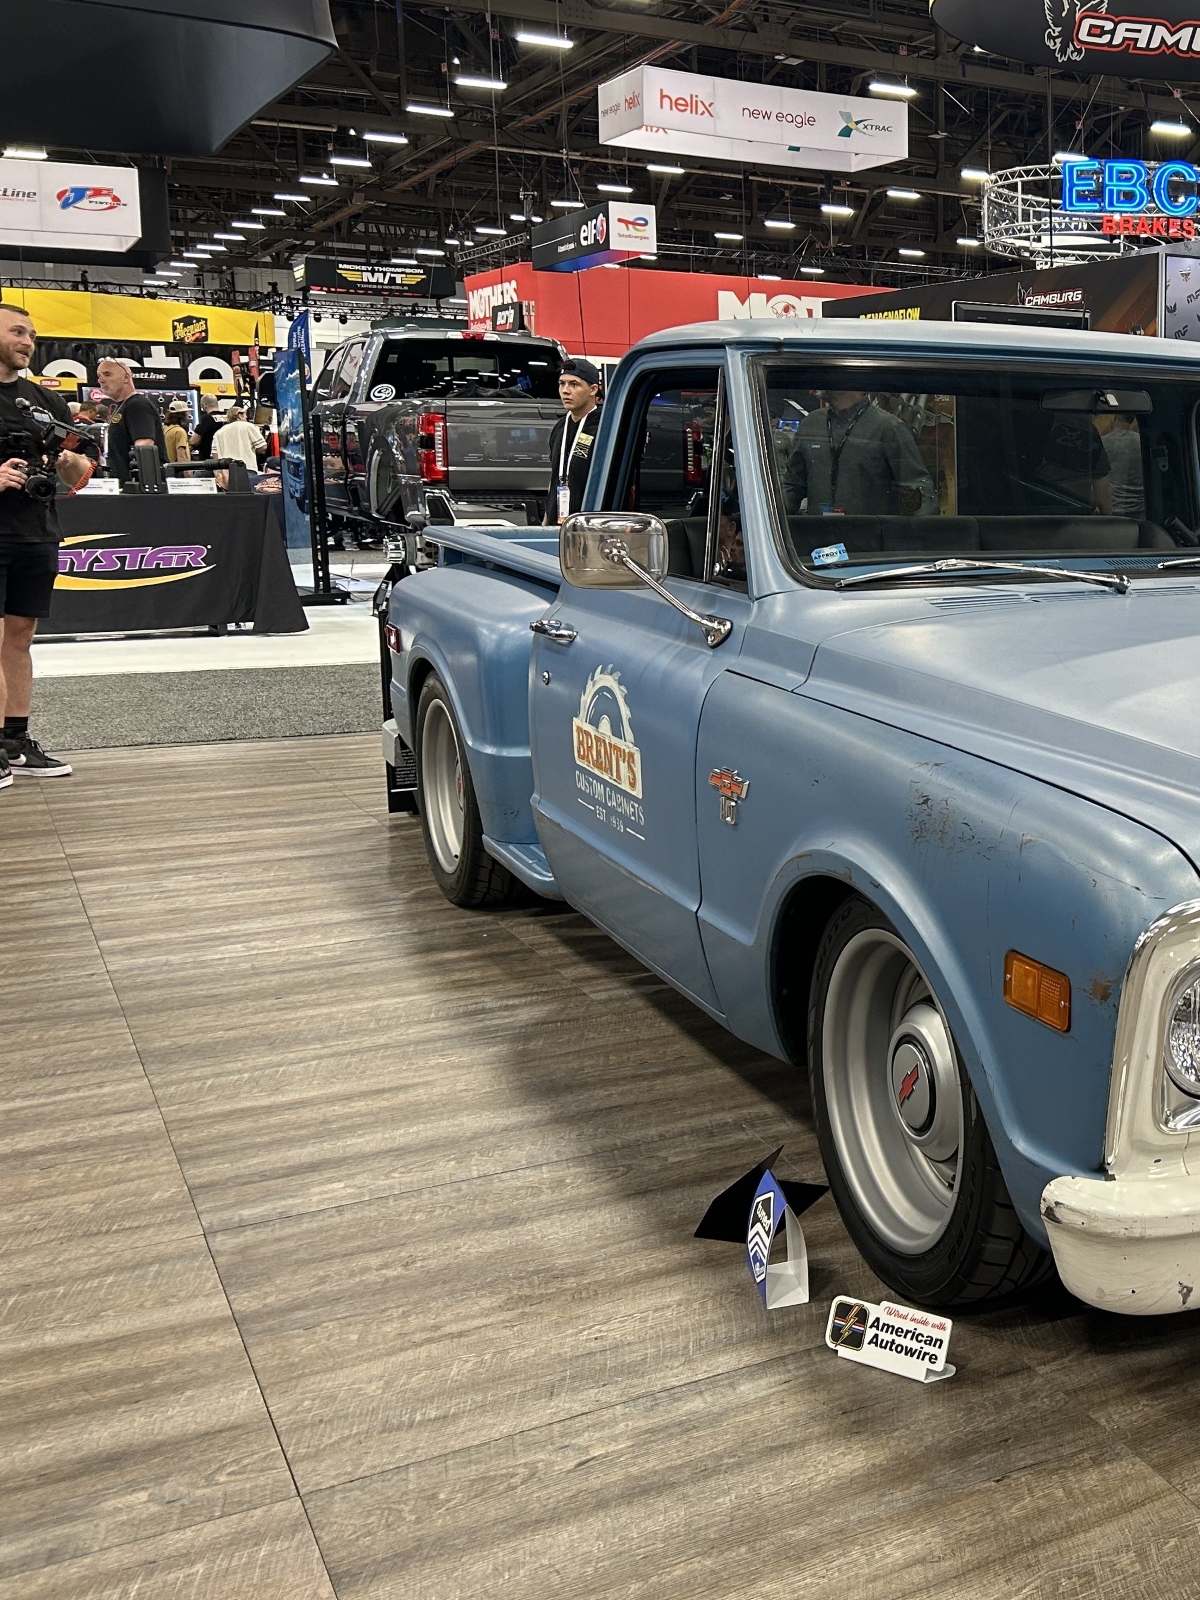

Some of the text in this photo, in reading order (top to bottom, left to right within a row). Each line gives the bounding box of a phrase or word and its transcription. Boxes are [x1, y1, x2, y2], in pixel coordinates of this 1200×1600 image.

[624, 90, 641, 112] helix
[660, 88, 893, 133] helix new eagle XTRAC
[1062, 158, 1200, 217] EBC
[580, 218, 597, 247] elf
[1102, 215, 1196, 238] BRAKES
[338, 263, 424, 274] MICKEY THOMPSON
[468, 279, 518, 321] MOTHERS
[1025, 290, 1083, 307] CAMBURG
[576, 724, 637, 791] BRENT'S
[575, 769, 645, 826] CUSTOM CABINETS
[868, 1316, 944, 1350] American
[883, 1306, 948, 1332] Wired inside with
[867, 1333, 939, 1365] Autowire
